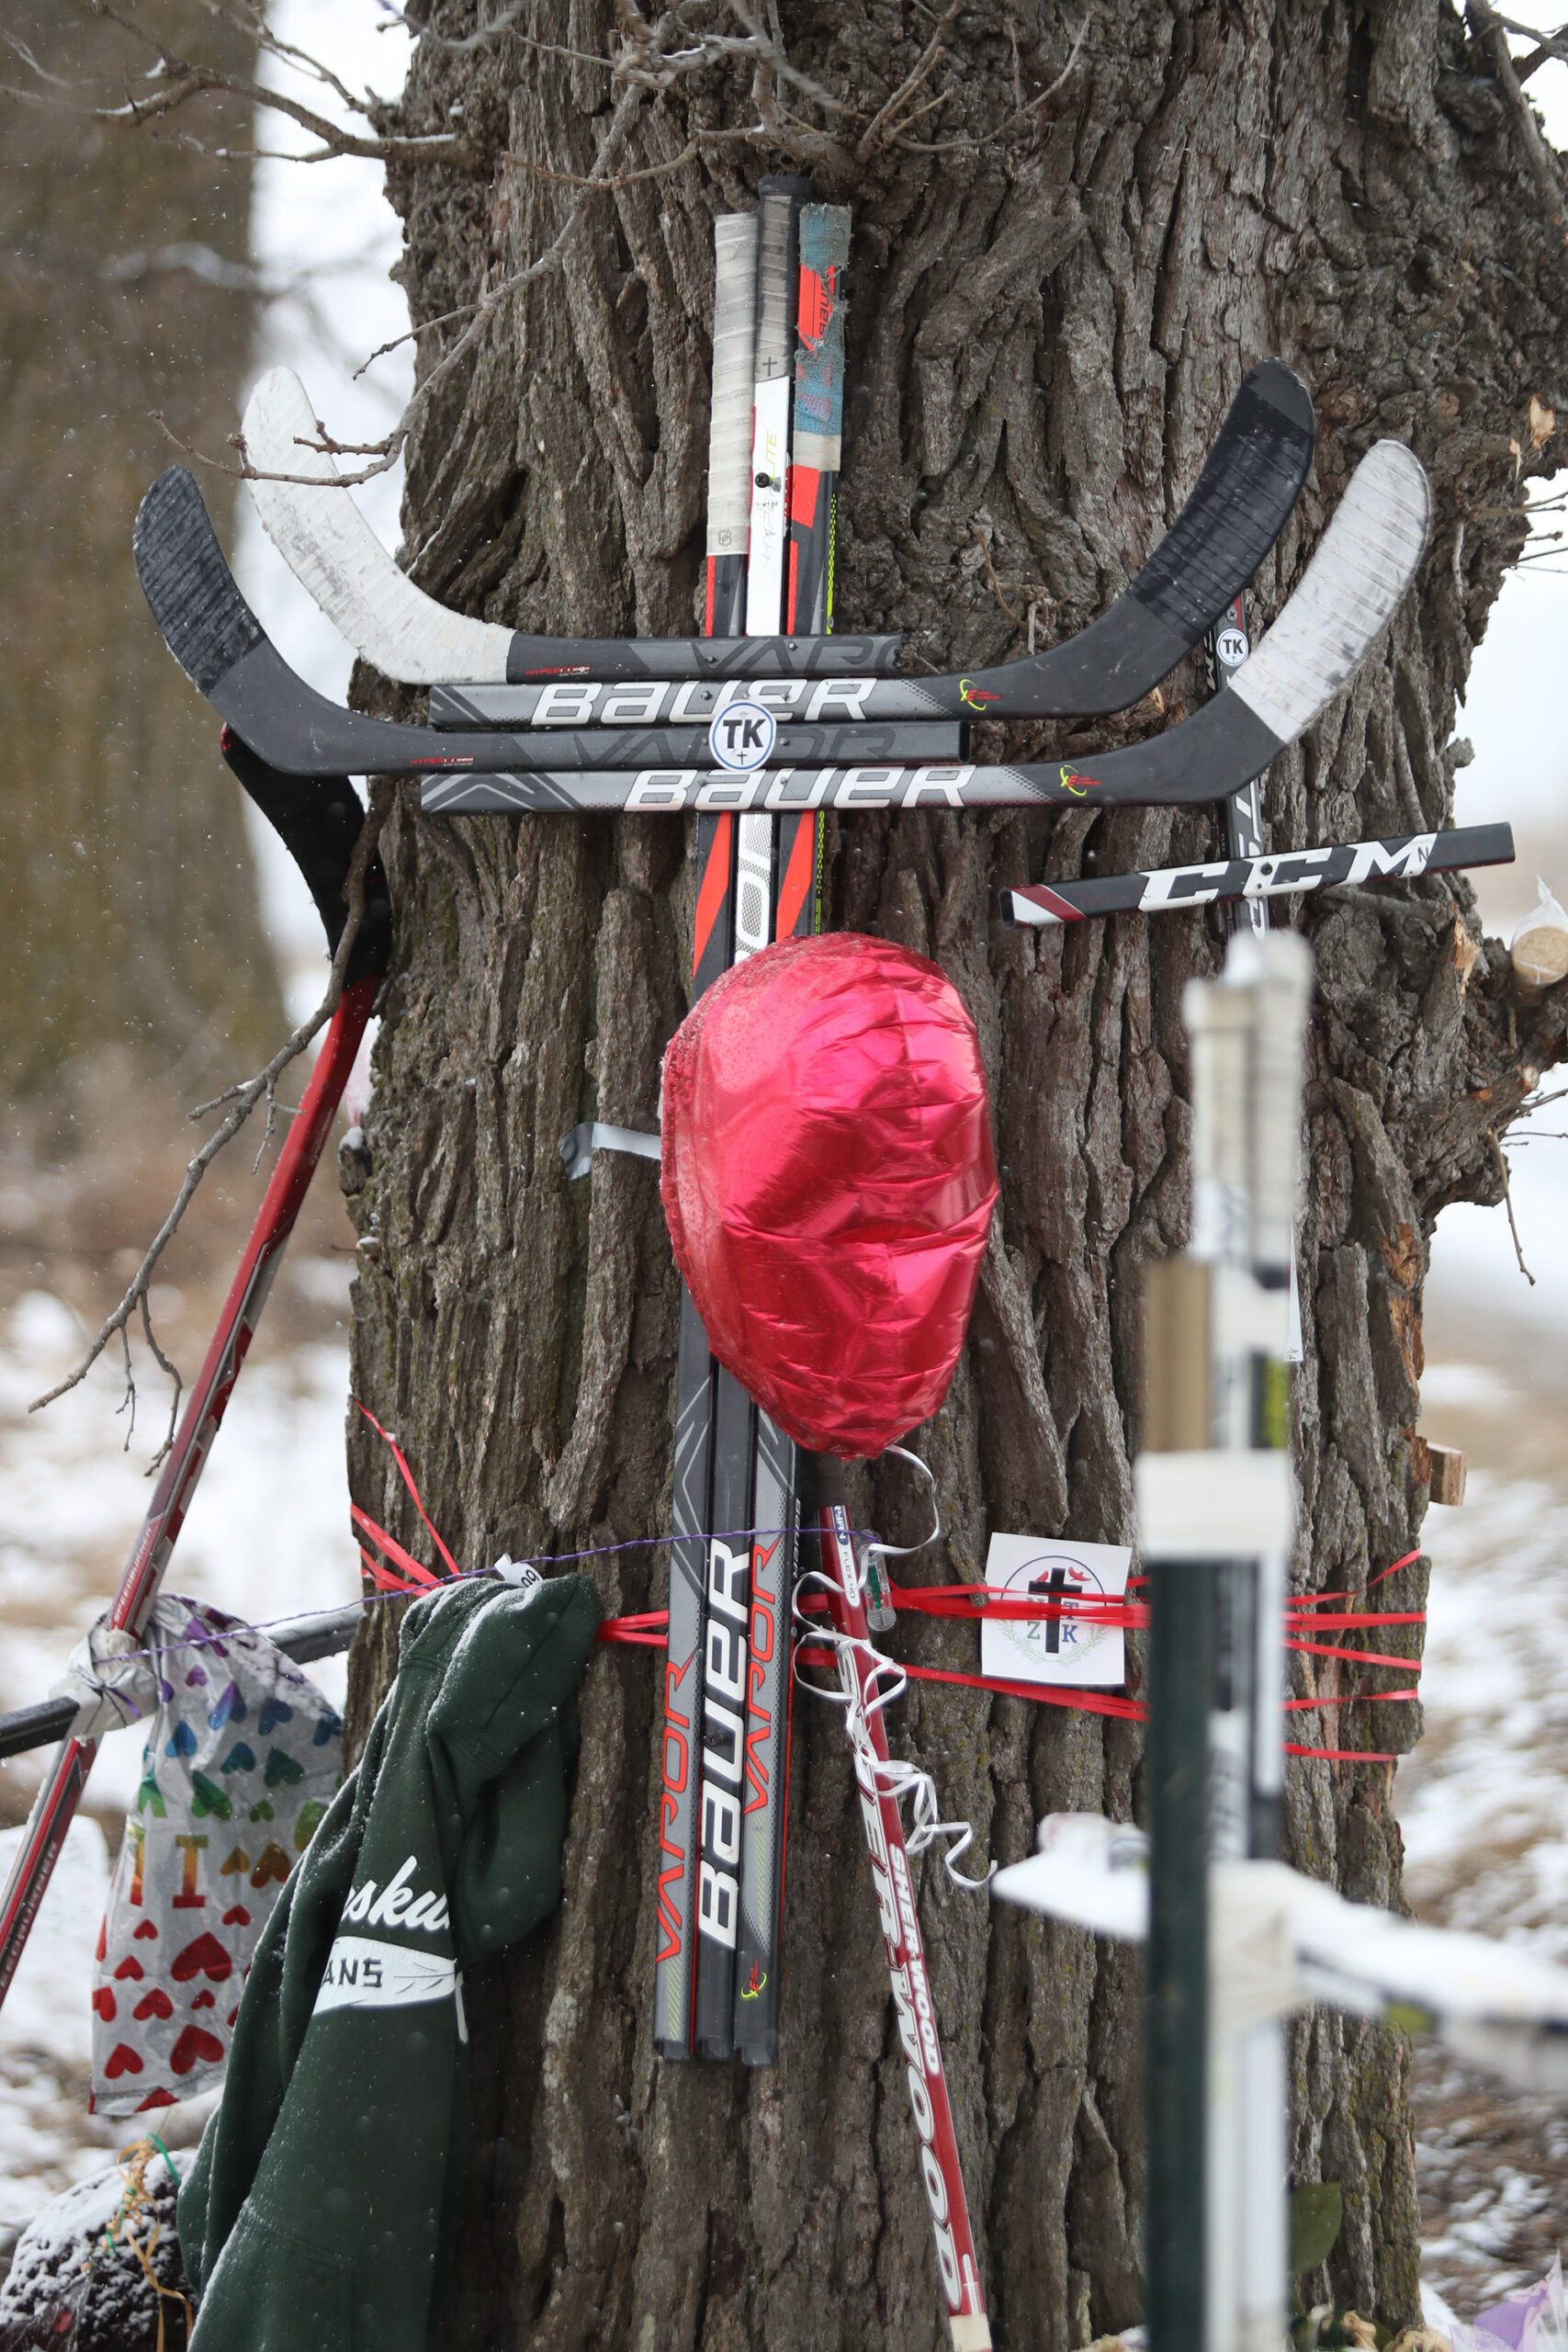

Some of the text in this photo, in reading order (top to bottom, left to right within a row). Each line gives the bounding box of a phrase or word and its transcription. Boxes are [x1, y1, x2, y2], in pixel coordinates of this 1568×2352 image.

[1223, 639, 1244, 654] TK
[531, 678, 877, 726] BAUER
[573, 728, 897, 766] VAOR
[723, 718, 766, 750] TK
[623, 764, 976, 812] BAUER
[1138, 831, 1438, 912] CCM
[842, 1551, 852, 1579] FLEX
[1026, 1621, 1078, 1643] Z K
[743, 1536, 782, 1815] VAPOR
[697, 1537, 750, 1950] BAUER
[655, 1649, 698, 1963] VAPOR
[321, 1956, 384, 1989] ANS
[888, 1842, 941, 2075] SHER-WOOD
